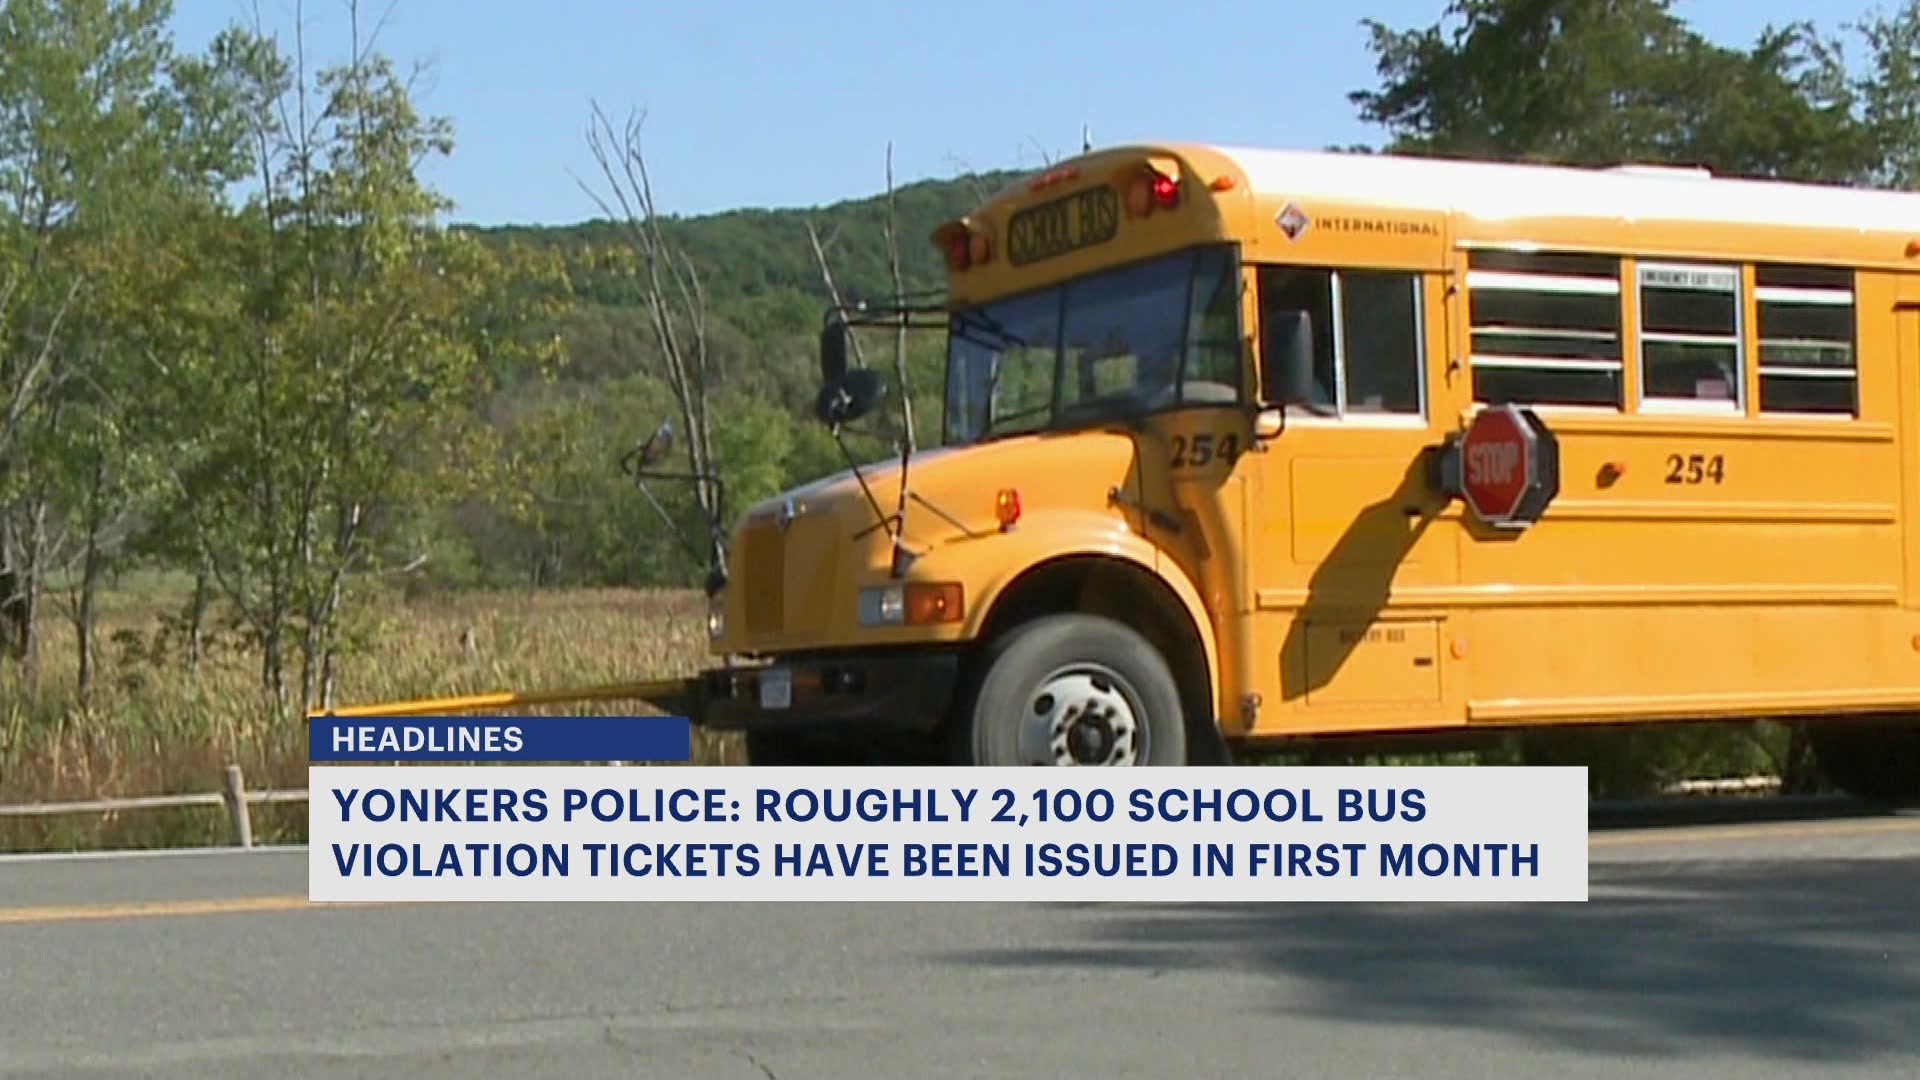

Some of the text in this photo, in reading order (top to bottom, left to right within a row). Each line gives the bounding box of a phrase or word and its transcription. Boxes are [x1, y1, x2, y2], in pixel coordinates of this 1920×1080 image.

[1315, 216, 1439, 236] INTERNATIONAL
[1169, 433, 1239, 469] 254
[1470, 442, 1519, 485] STOP
[1664, 453, 1724, 485] 254
